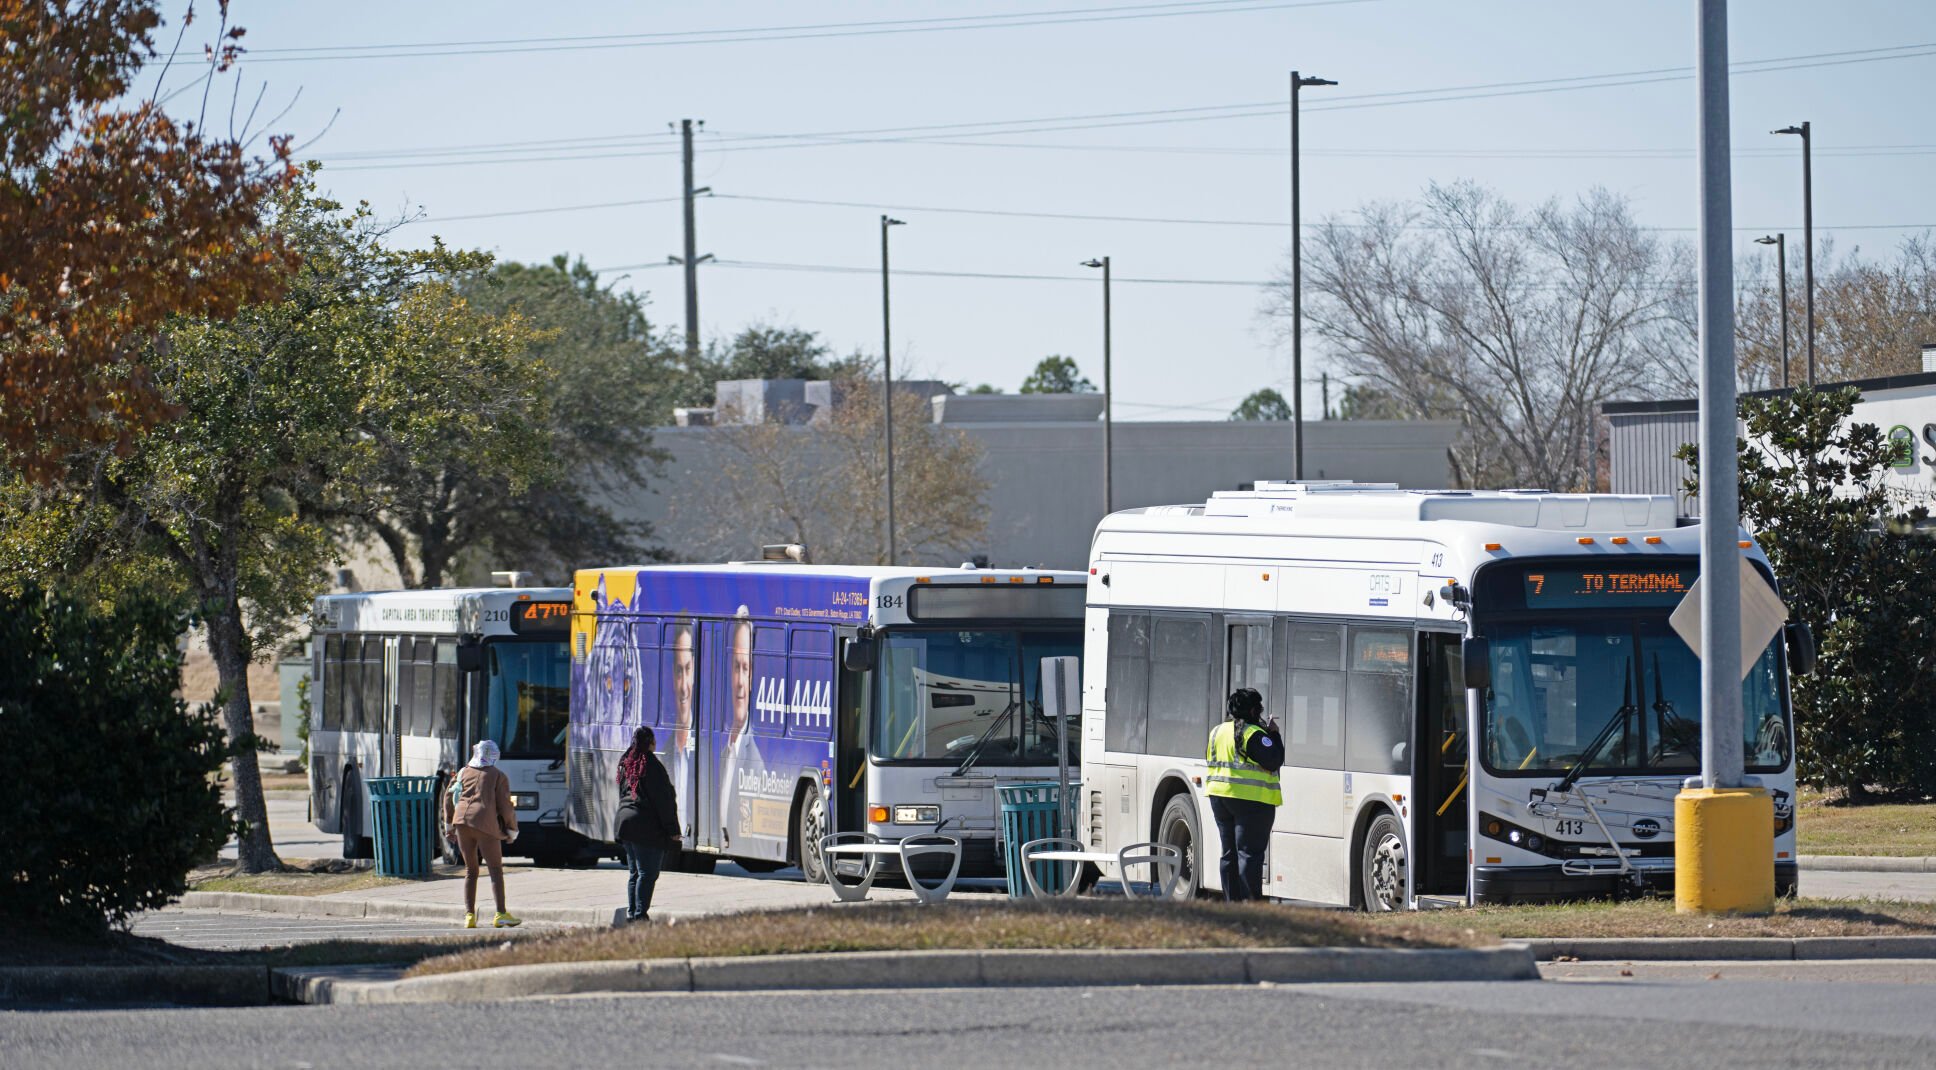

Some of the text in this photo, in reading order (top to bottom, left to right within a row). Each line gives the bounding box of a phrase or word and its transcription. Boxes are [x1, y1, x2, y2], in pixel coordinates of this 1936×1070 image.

[1432, 552, 1443, 567] 413
[1528, 574, 1684, 594] 7 TO TERMINAL
[876, 595, 904, 608] 184
[484, 609, 508, 622] 210
[739, 768, 793, 796] Dudley DeBosier
[1556, 821, 1583, 835] 413
